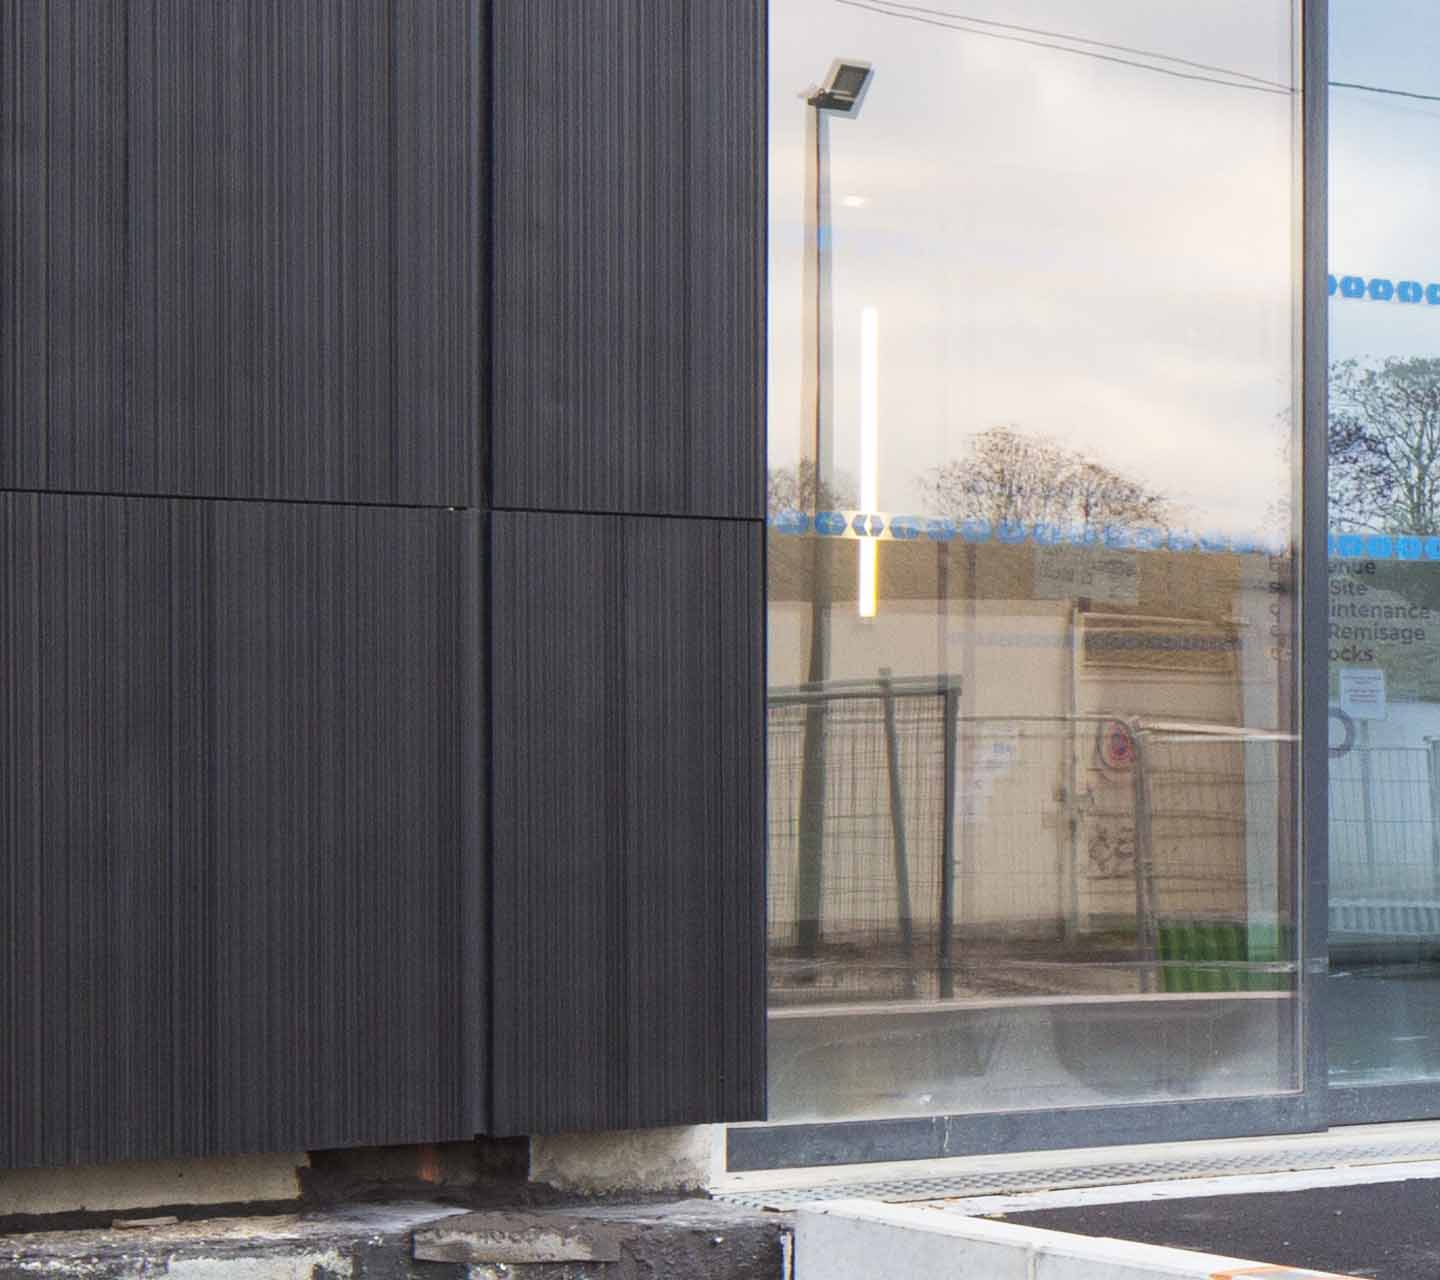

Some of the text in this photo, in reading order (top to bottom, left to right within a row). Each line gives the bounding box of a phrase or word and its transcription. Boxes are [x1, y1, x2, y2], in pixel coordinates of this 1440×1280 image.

[1329, 579, 1369, 596] Site
[1329, 598, 1432, 619] intenance
[1327, 622, 1426, 645] Remisage
[1328, 645, 1374, 662] ocks
